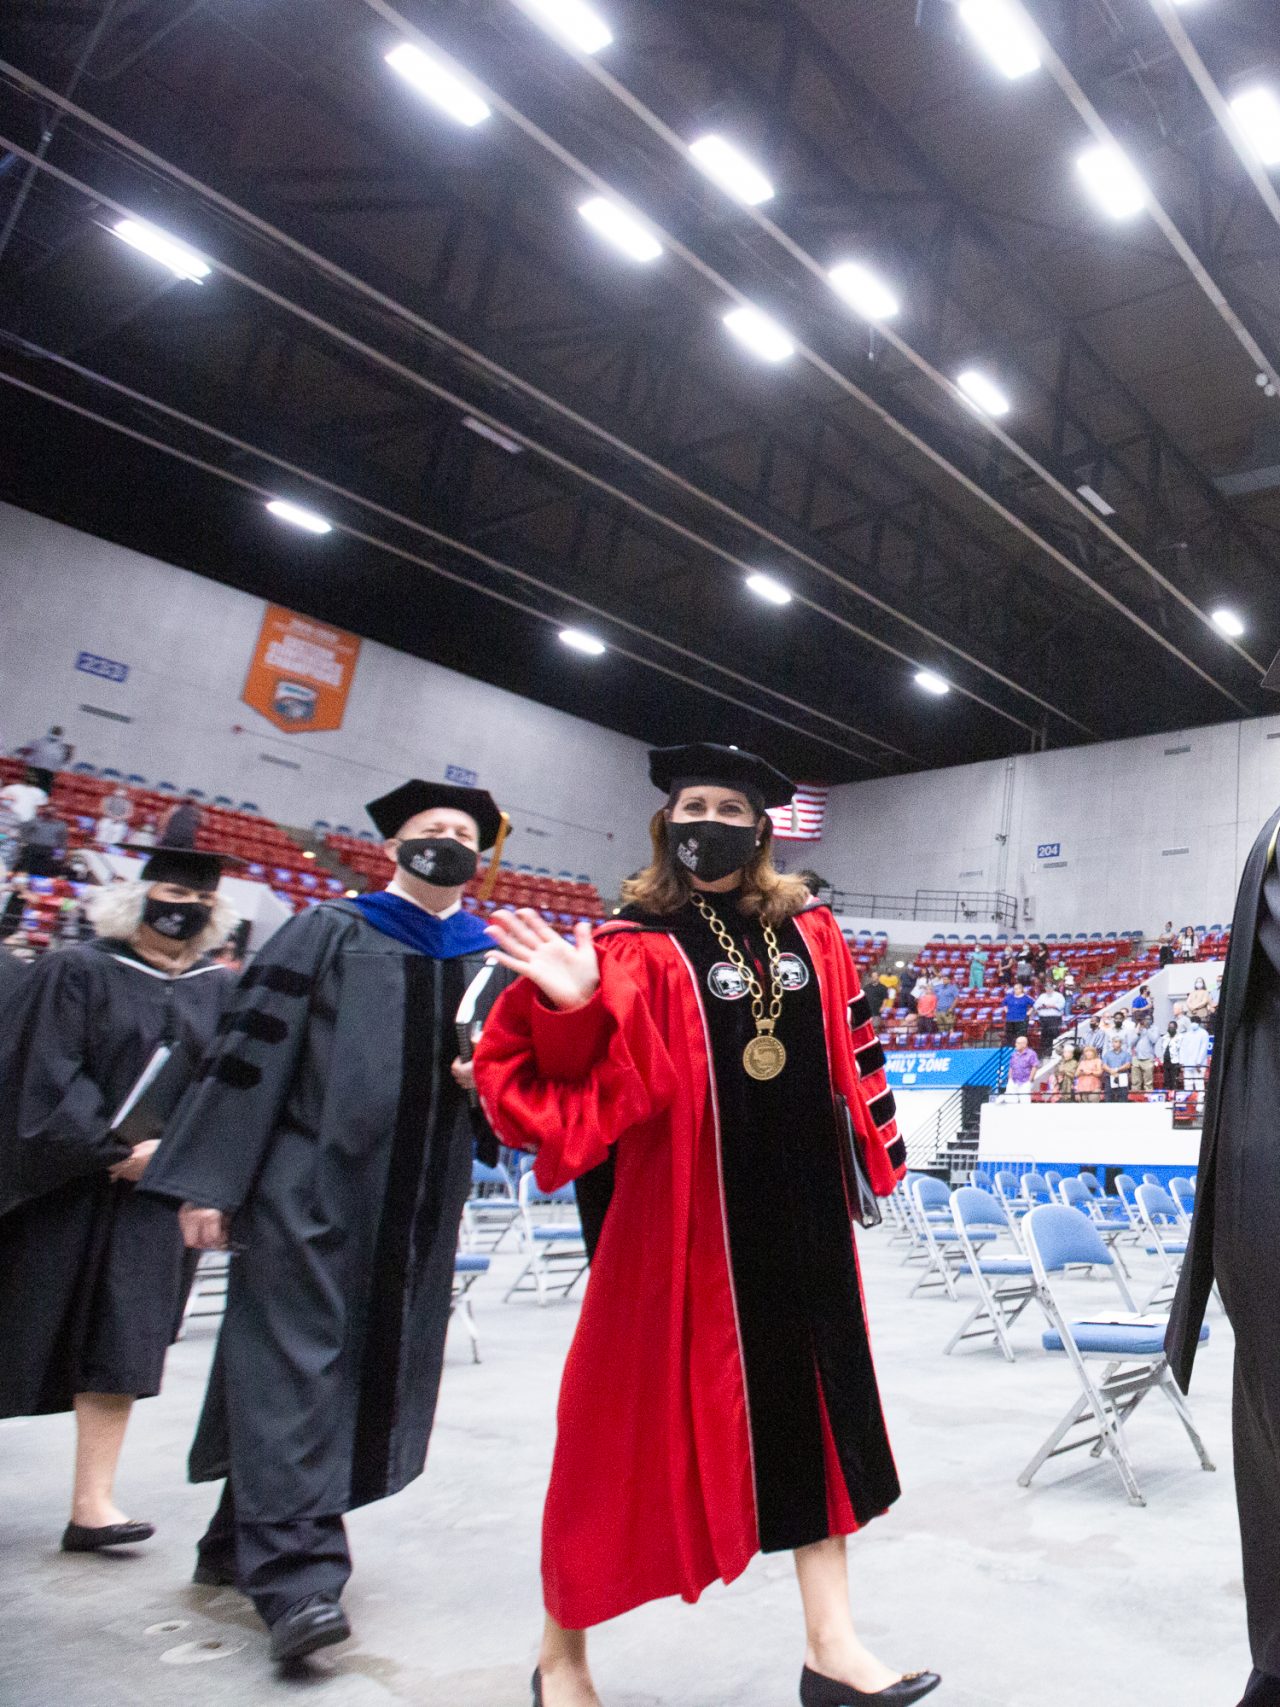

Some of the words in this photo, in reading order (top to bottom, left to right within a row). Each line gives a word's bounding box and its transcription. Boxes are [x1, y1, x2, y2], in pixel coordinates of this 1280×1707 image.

[1039, 845, 1057, 857] 204
[883, 1059, 916, 1072] MILY
[917, 1057, 951, 1072] ZONE
